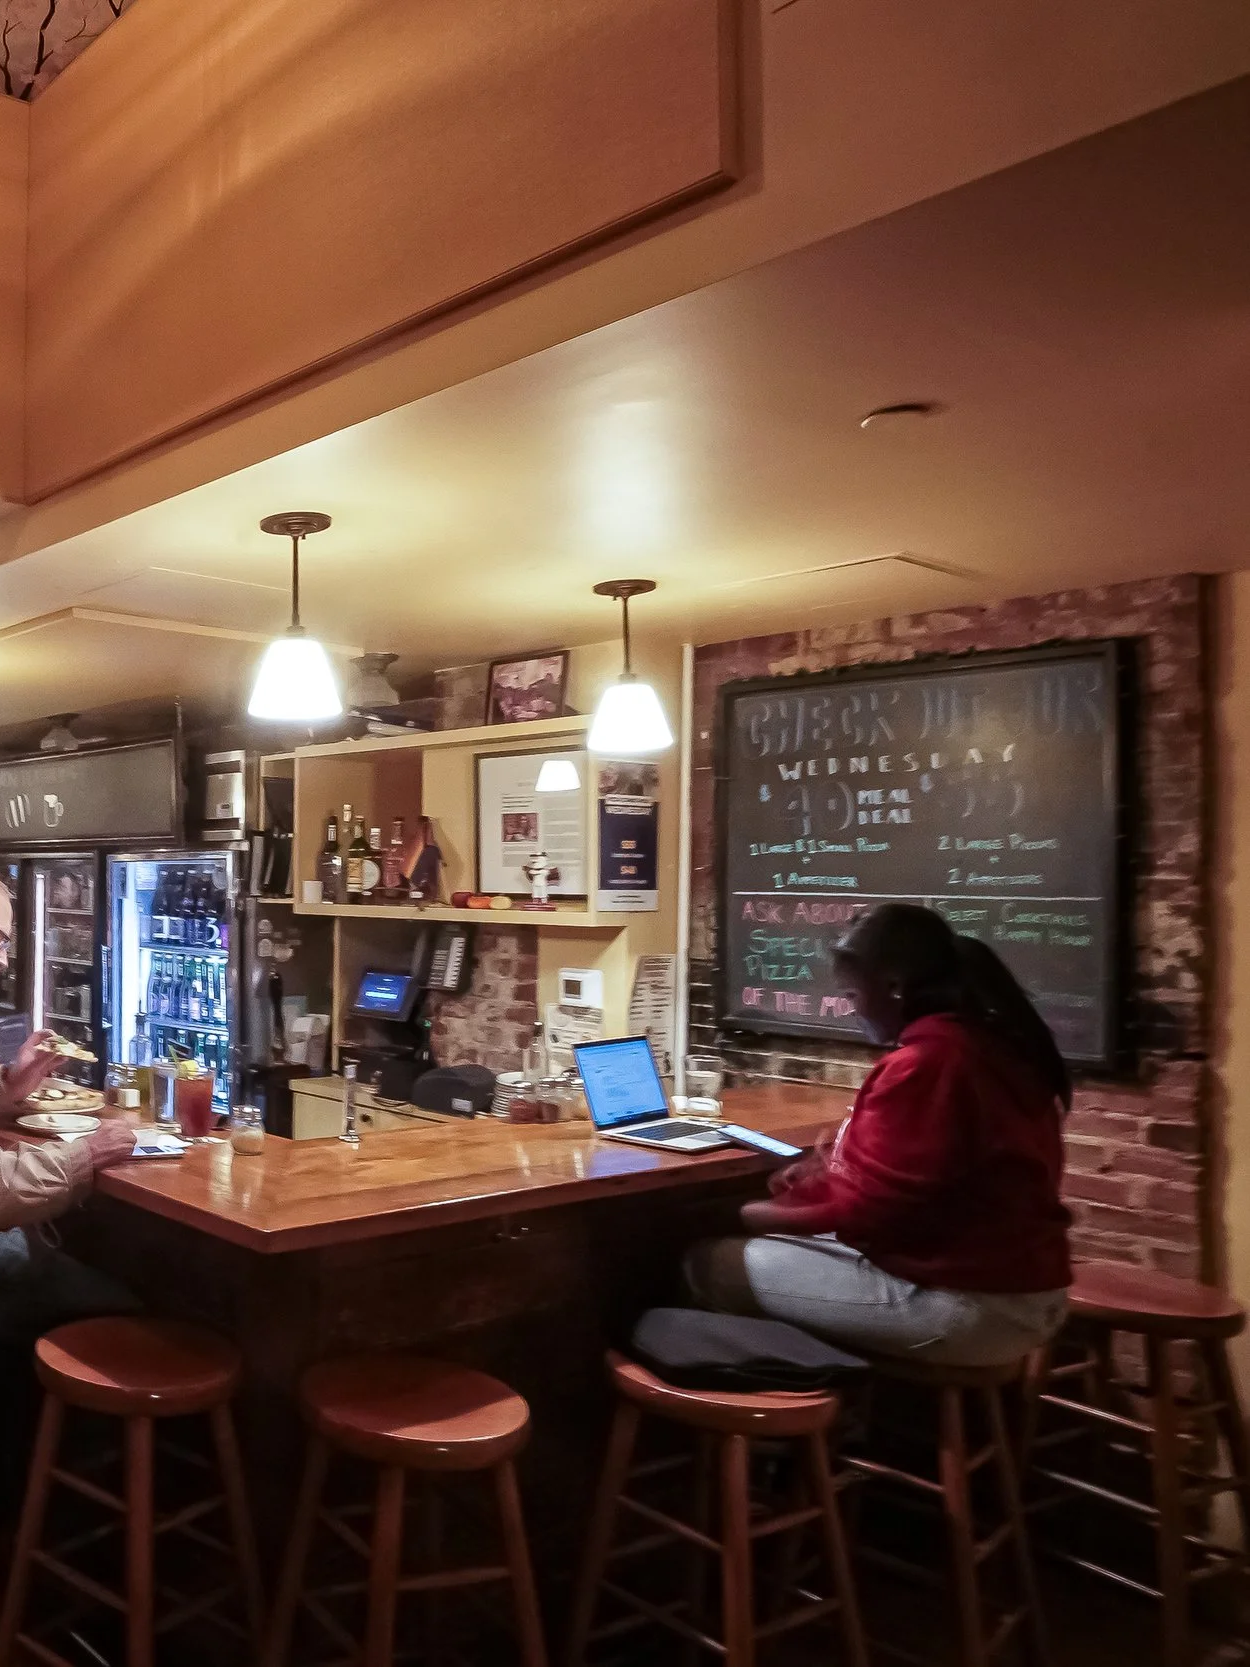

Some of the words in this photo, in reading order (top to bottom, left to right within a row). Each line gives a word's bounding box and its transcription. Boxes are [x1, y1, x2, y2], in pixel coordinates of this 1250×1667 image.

[777, 743, 1015, 781] WEDNESDAY
[857, 788, 913, 804] MEAL
[857, 809, 912, 824] DEAL
[937, 836, 950, 850] 2
[772, 873, 784, 888] 1
[947, 868, 961, 884] 2
[741, 901, 784, 924] ASK
[743, 955, 813, 981] PIZZA
[742, 986, 766, 1007] OF
[773, 990, 812, 1016] THE
